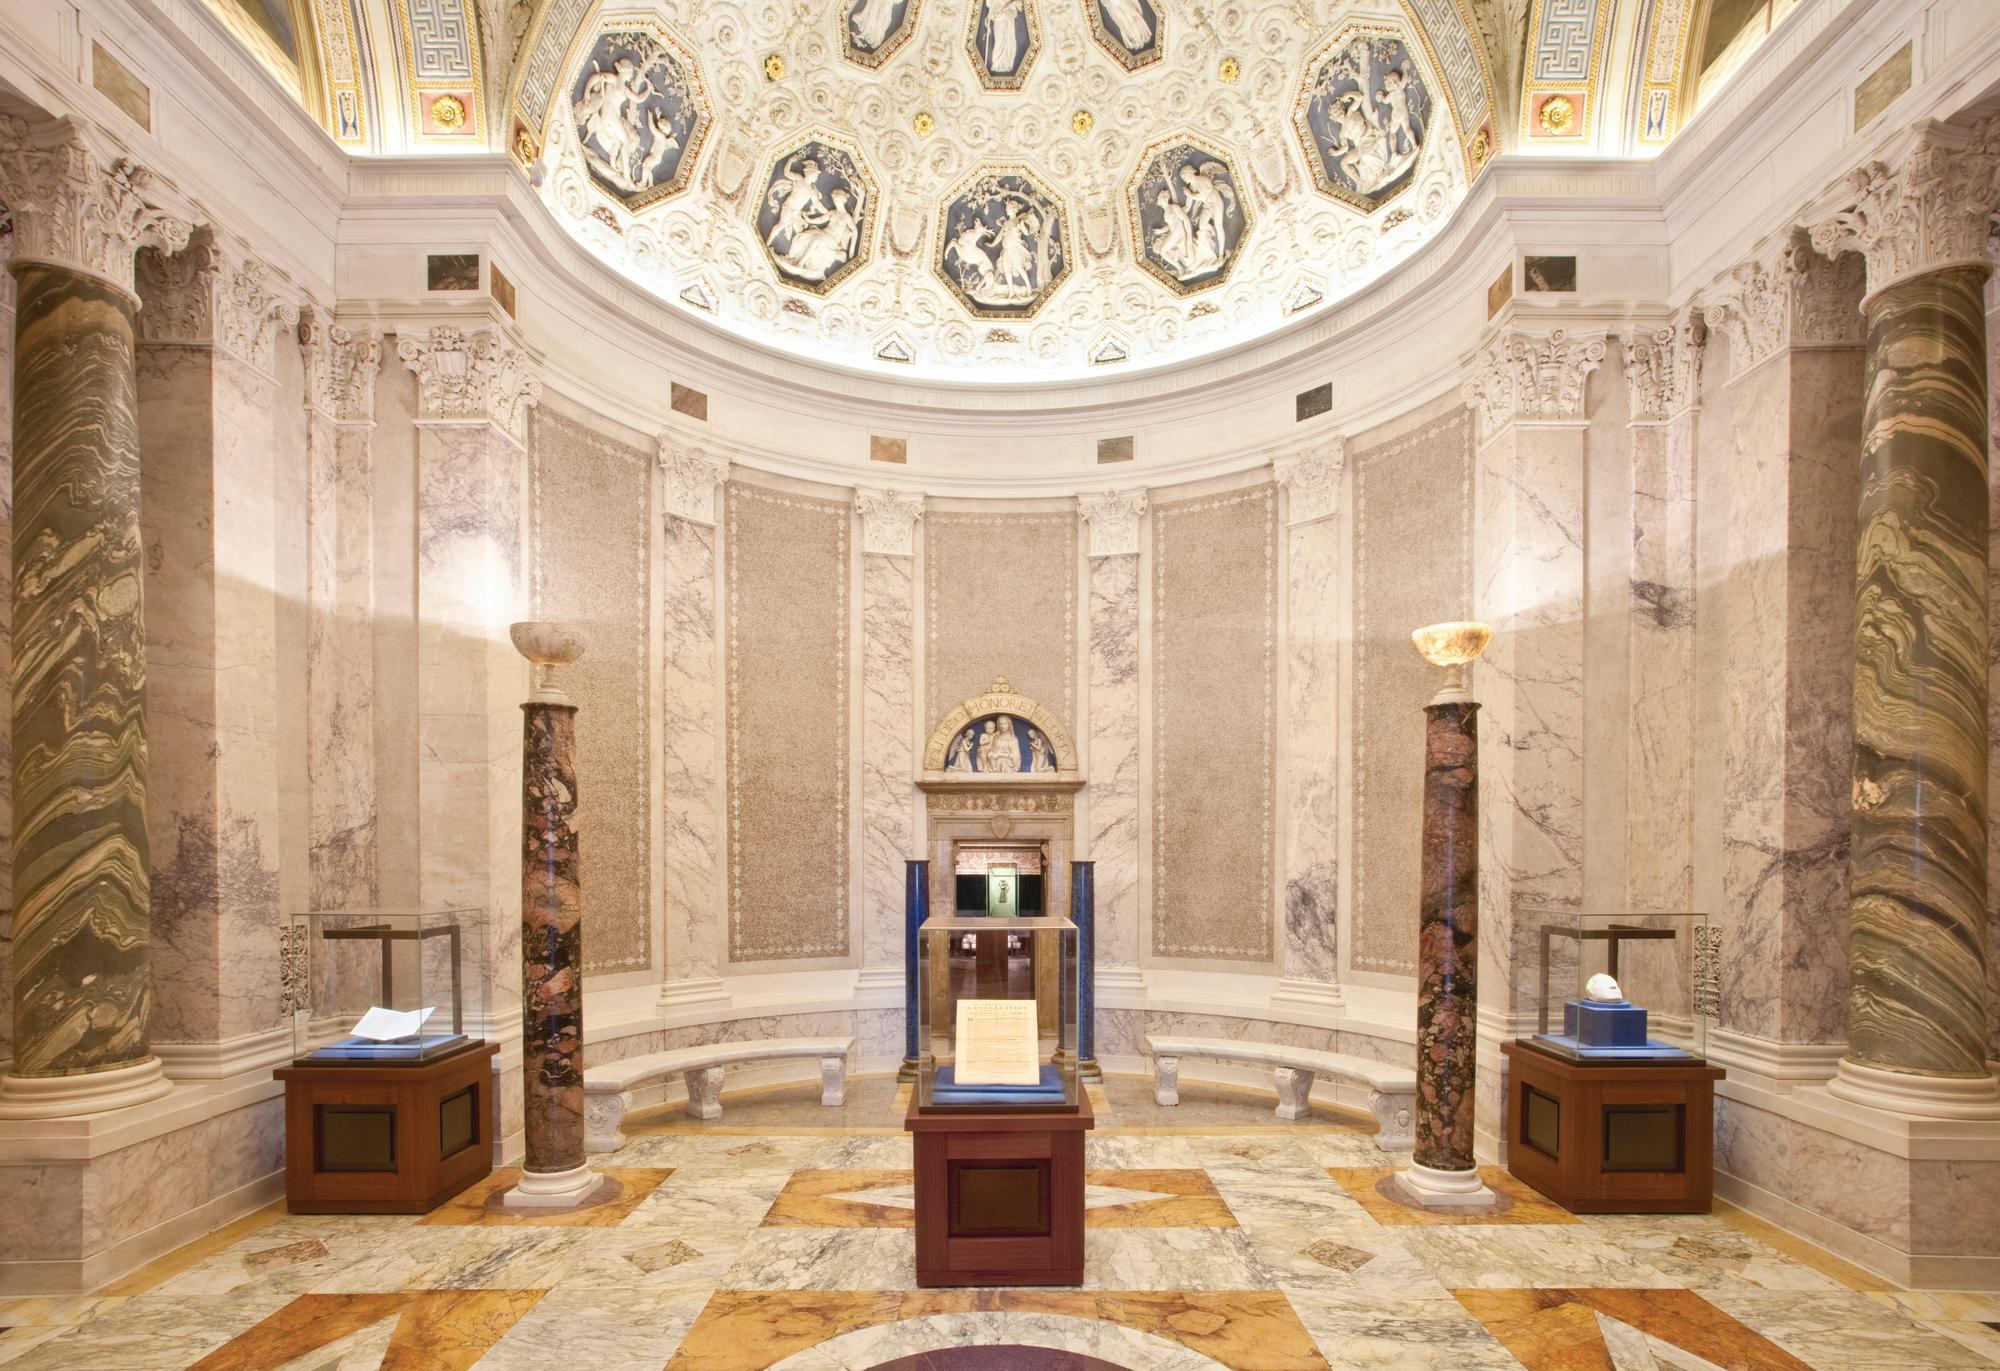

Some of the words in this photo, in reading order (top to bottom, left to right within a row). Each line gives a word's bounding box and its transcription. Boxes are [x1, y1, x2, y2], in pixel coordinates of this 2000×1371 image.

[927, 740, 944, 767] SOLI
[940, 712, 965, 737] DEO
[967, 697, 1016, 711] HONOR
[1019, 701, 1034, 714] ET
[1034, 710, 1071, 760] GLORIA
